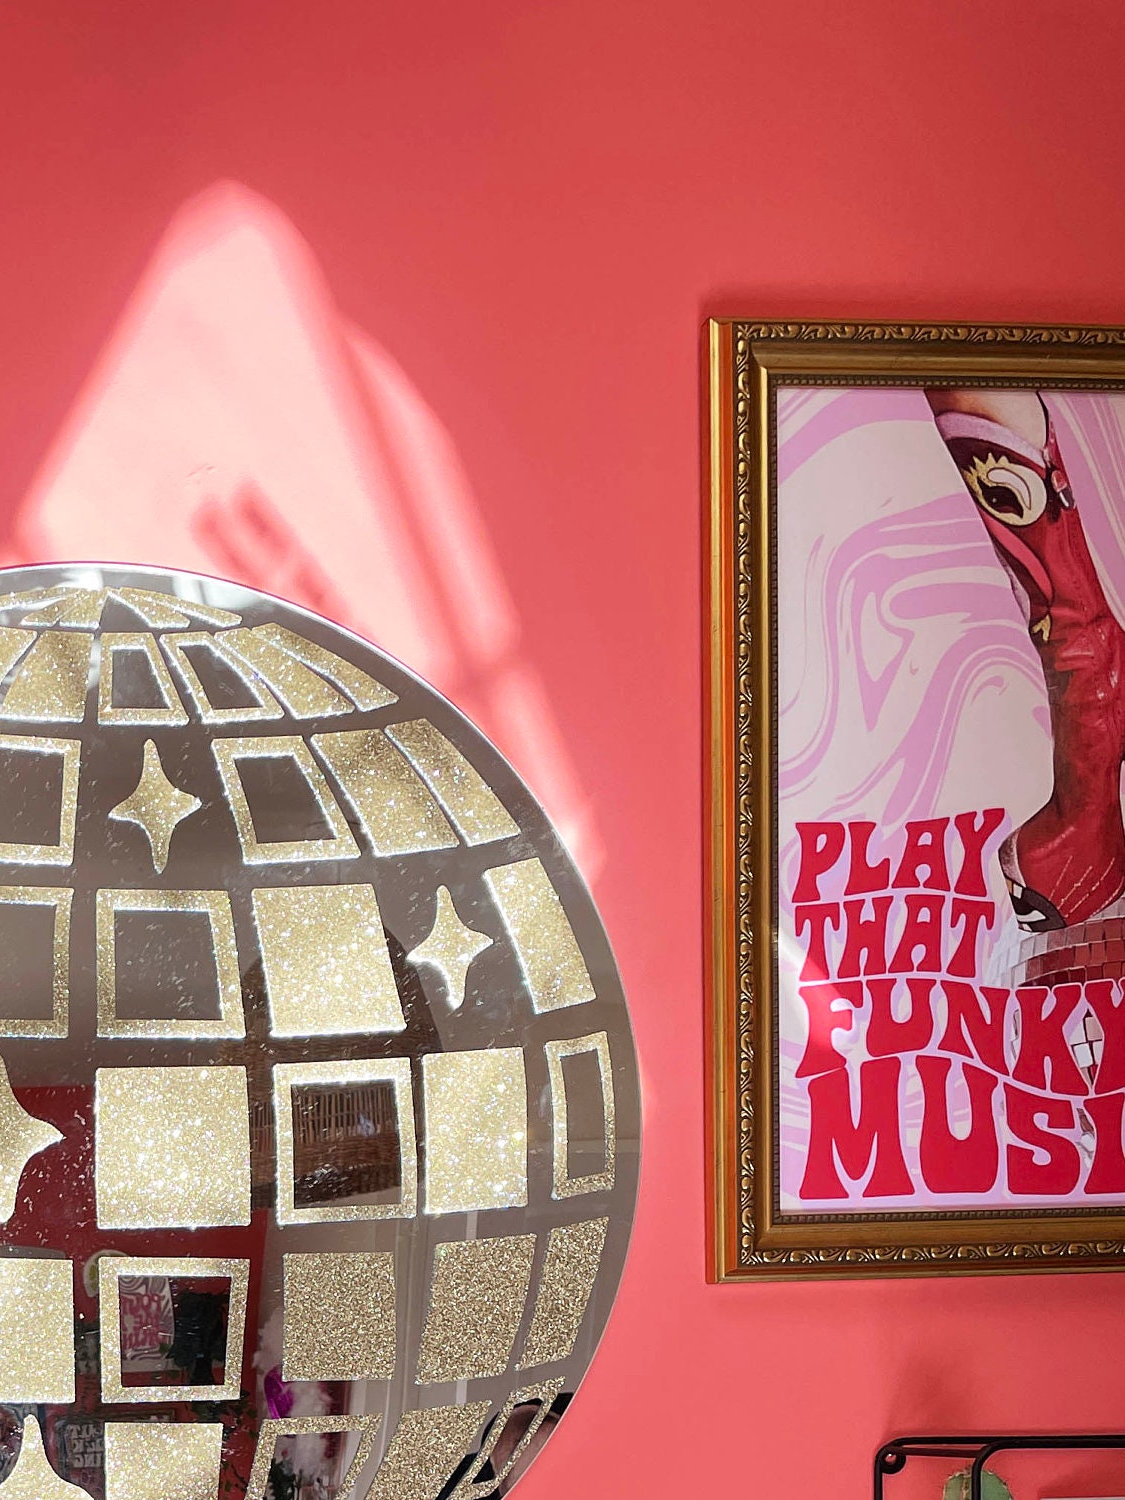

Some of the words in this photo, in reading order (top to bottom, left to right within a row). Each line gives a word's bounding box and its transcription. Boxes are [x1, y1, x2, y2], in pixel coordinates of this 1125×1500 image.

[791, 807, 1006, 903] PLAY
[794, 894, 995, 982] THAT
[798, 1055, 1125, 1199] MUSI
